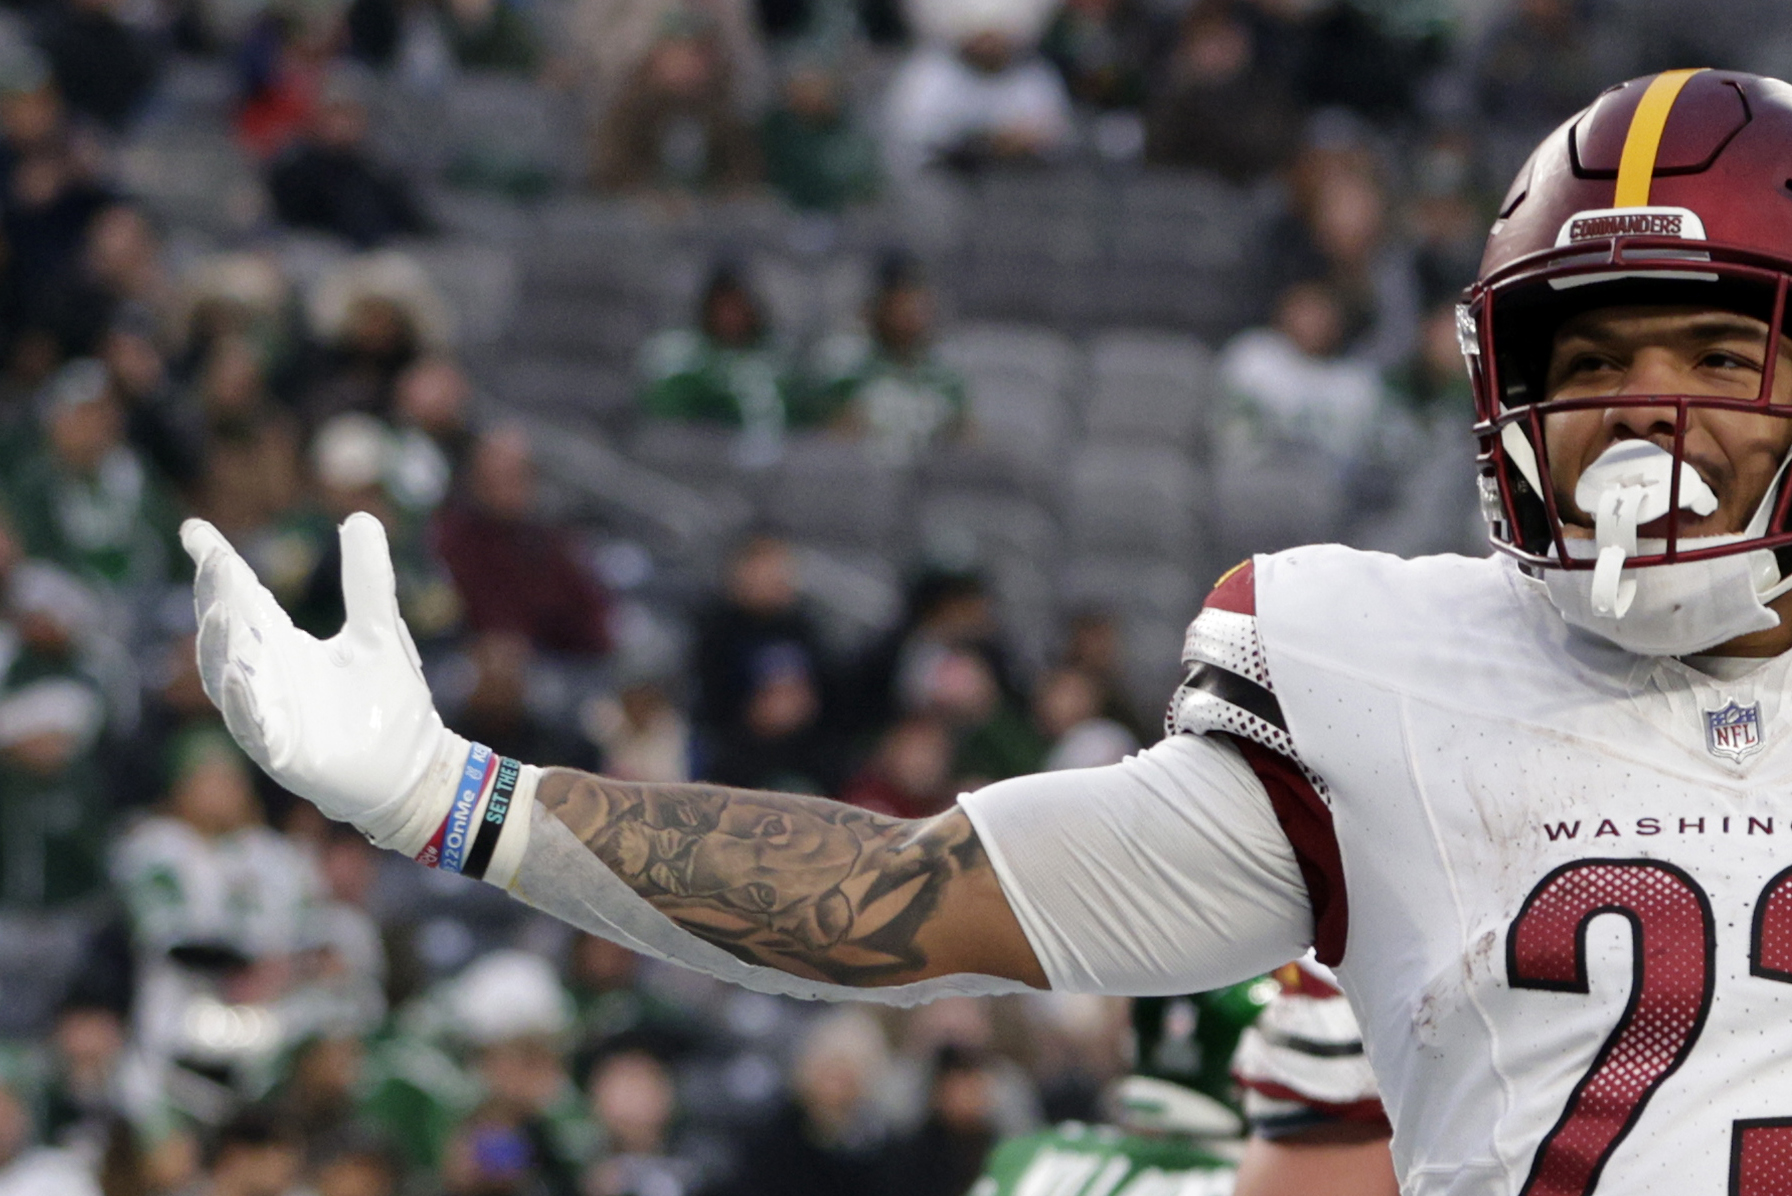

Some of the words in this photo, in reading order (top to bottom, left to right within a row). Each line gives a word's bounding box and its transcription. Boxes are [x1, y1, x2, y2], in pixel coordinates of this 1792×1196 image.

[1571, 214, 1683, 241] COMMANDERS
[1715, 724, 1755, 748] NFL
[497, 765, 518, 792] THE
[486, 792, 510, 825] SET
